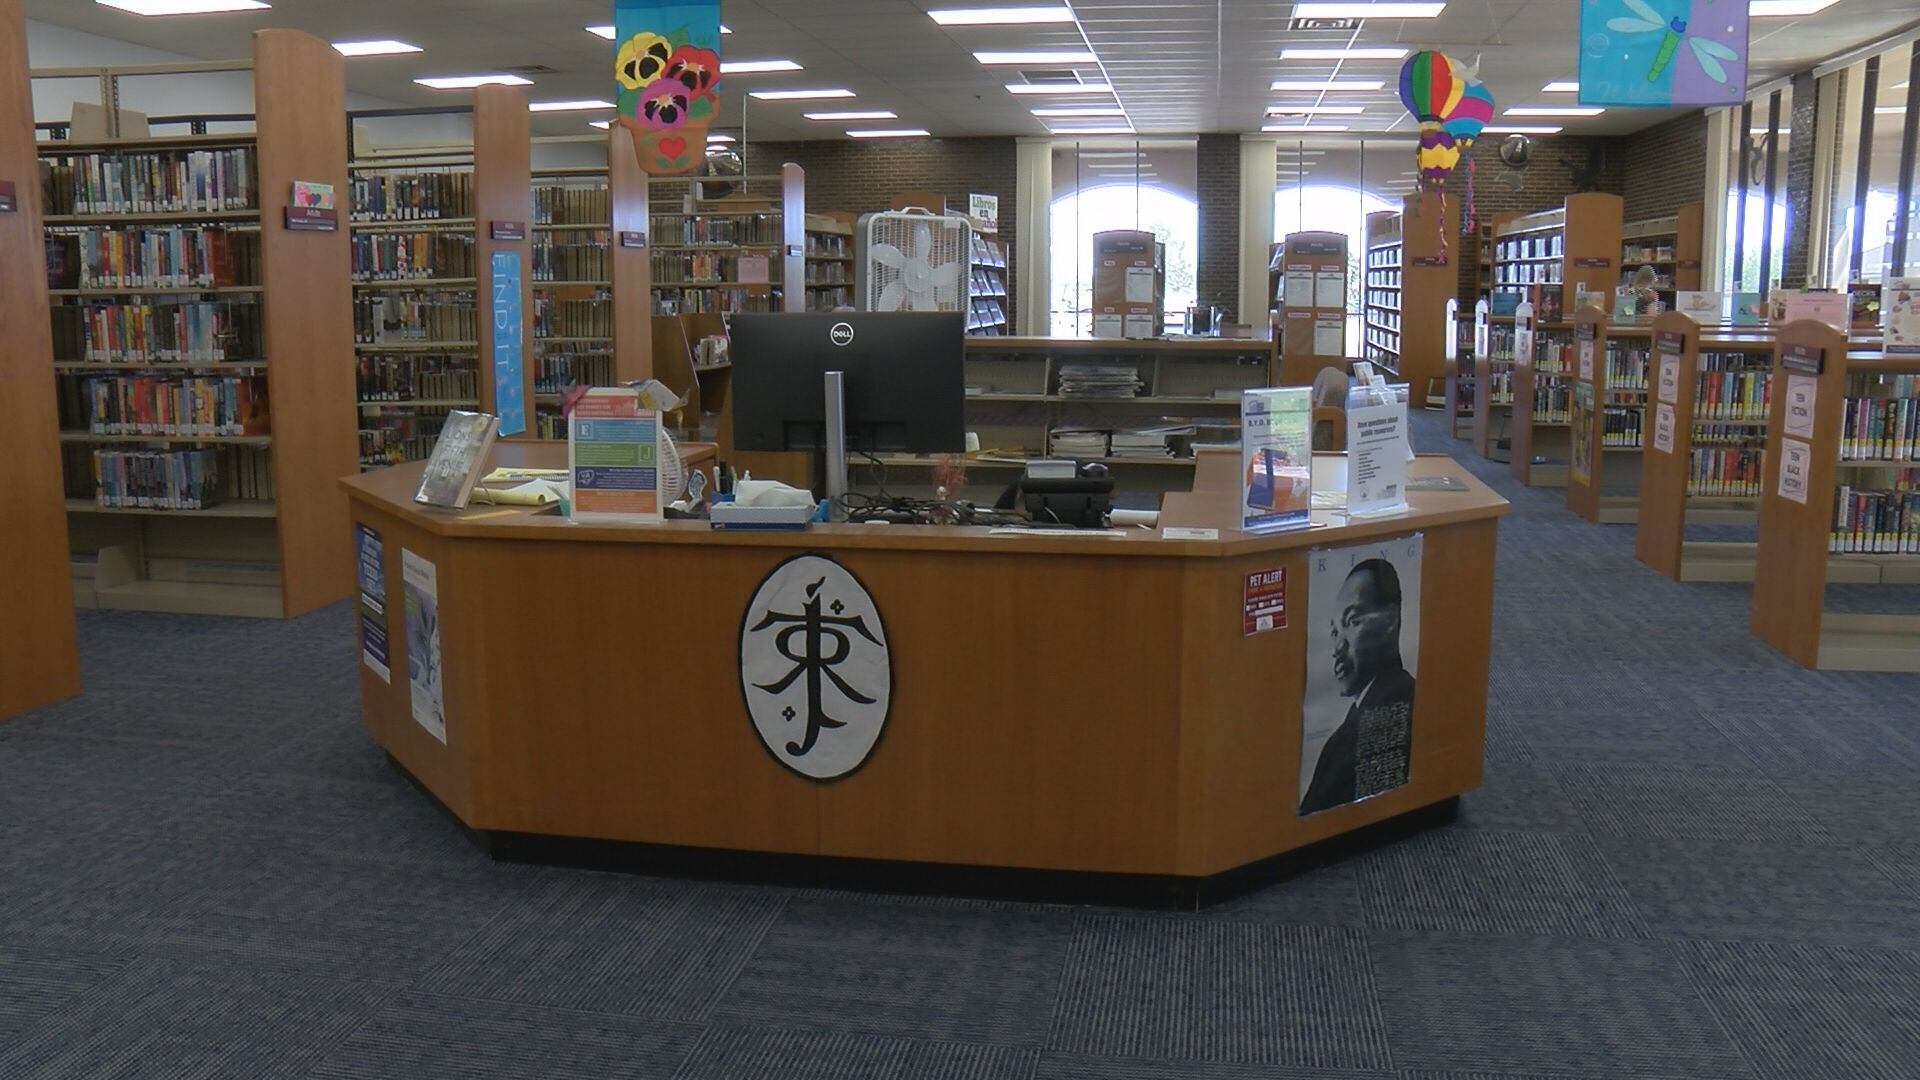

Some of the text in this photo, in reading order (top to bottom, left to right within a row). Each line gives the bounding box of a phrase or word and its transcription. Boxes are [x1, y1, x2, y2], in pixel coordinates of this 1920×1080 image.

[973, 196, 996, 210] Libros
[980, 209, 989, 217] en
[494, 254, 510, 371] FIND IT
[833, 330, 851, 338] DELL
[581, 424, 591, 436] E
[1250, 570, 1283, 587] PET ALERT
